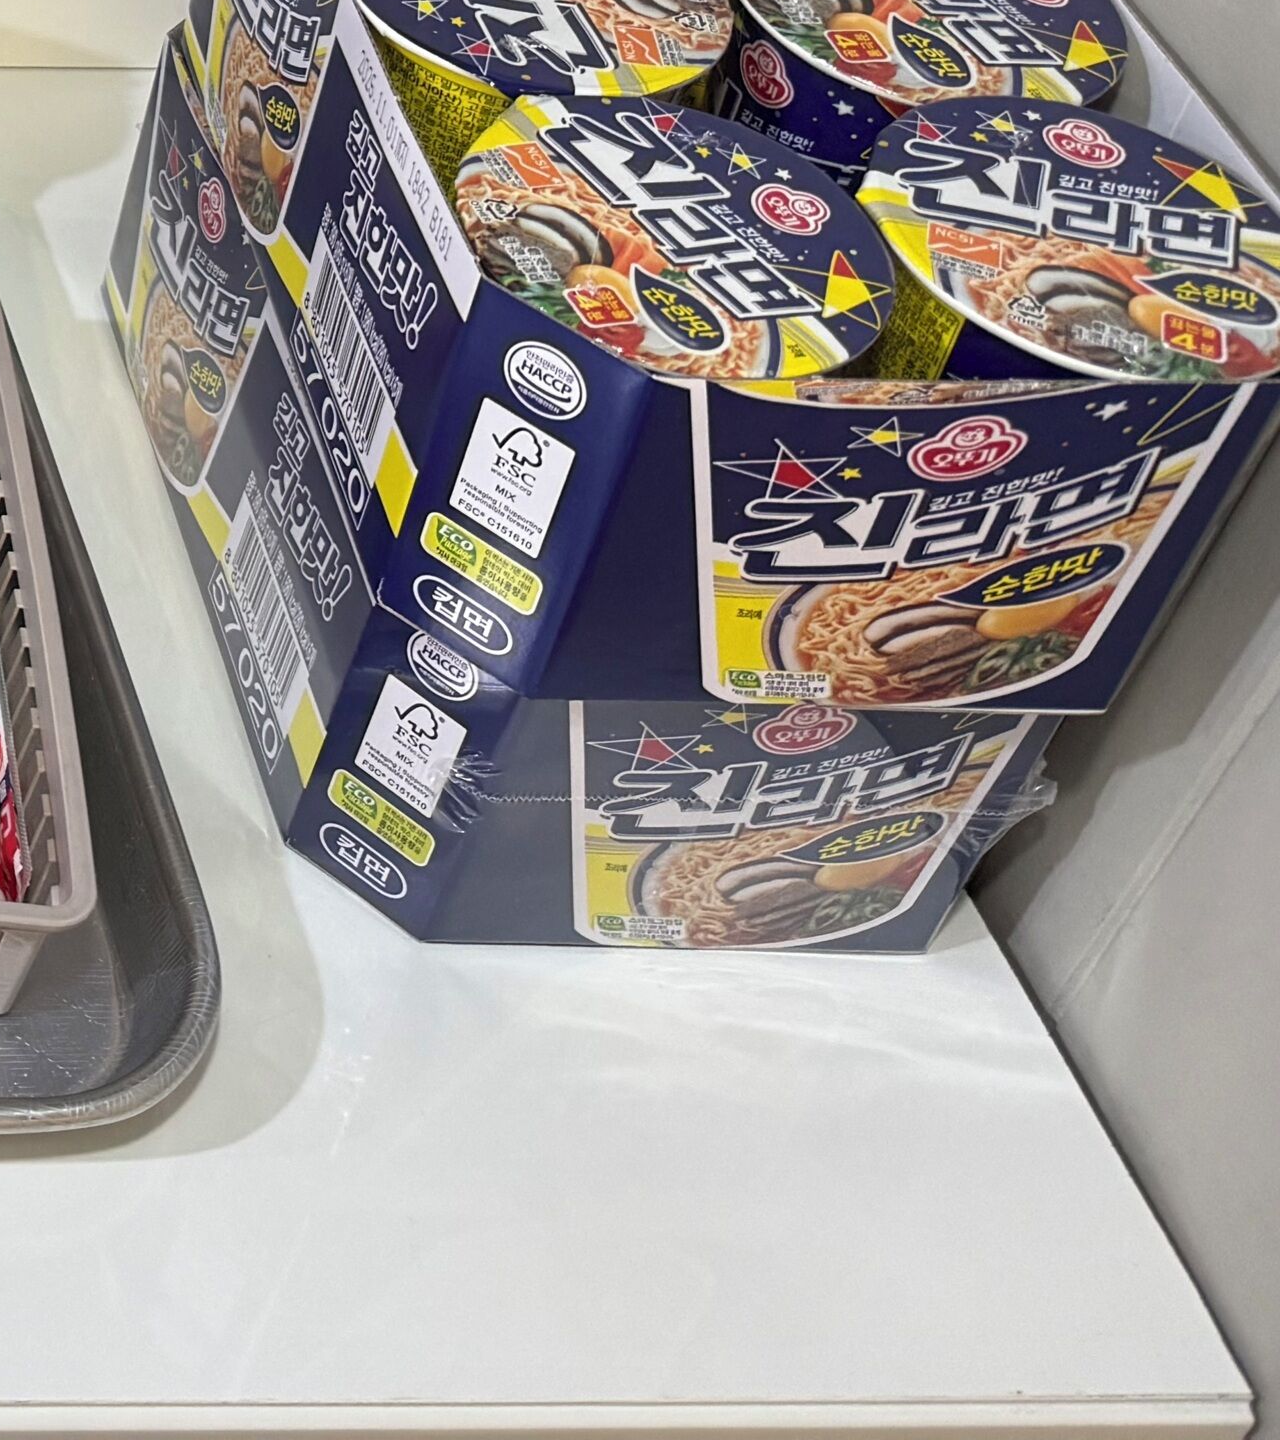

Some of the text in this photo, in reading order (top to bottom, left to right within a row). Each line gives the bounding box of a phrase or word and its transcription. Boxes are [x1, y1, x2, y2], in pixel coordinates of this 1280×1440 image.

[620, 39, 636, 62] NCSI
[897, 30, 968, 80] 순한맛
[265, 95, 296, 134] 순한맛
[739, 108, 815, 154] 깊고 진한맛!
[347, 109, 383, 194] 깊고
[524, 145, 550, 172] NCSI
[897, 138, 1238, 270] 진라면
[1058, 174, 1159, 202] 깊고 진한맛!
[469, 199, 493, 224] OTHER
[539, 112, 822, 320] 진라면
[739, 220, 790, 265] 진한맛!
[935, 226, 975, 246] NCSI
[150, 168, 250, 357] 진라면
[339, 168, 438, 351] 진한맛!
[641, 285, 720, 340] 순한맛
[1172, 280, 1260, 311] 순한맛
[1006, 312, 1046, 329] OTHER
[189, 360, 223, 398] 순한맛
[521, 360, 573, 397] HACCP
[272, 392, 311, 472] 깊고
[490, 466, 533, 498] www.fsc.org
[493, 454, 538, 489] FSC
[930, 466, 1064, 513] 깊고 진한맛!
[459, 477, 544, 535] Packaging Supporting
[463, 488, 536, 537] responsible forestry
[494, 482, 518, 505] MIX
[486, 515, 533, 551] C151610
[727, 445, 1161, 584] 진라면
[264, 446, 352, 622] 진한맛!
[437, 526, 475, 553] ECO
[980, 546, 1104, 604] 순한맛
[431, 585, 495, 644] 컵면
[421, 644, 467, 681] HACCP
[730, 670, 757, 682] ECO
[395, 724, 433, 758] FSC
[395, 749, 415, 769] MIX
[773, 745, 891, 780] 깊고 진한맛!
[343, 781, 376, 808] ECO
[387, 777, 428, 811] C151610
[599, 732, 976, 841] 진라면
[818, 813, 926, 861] 순한맛
[336, 833, 391, 889] 컵면
